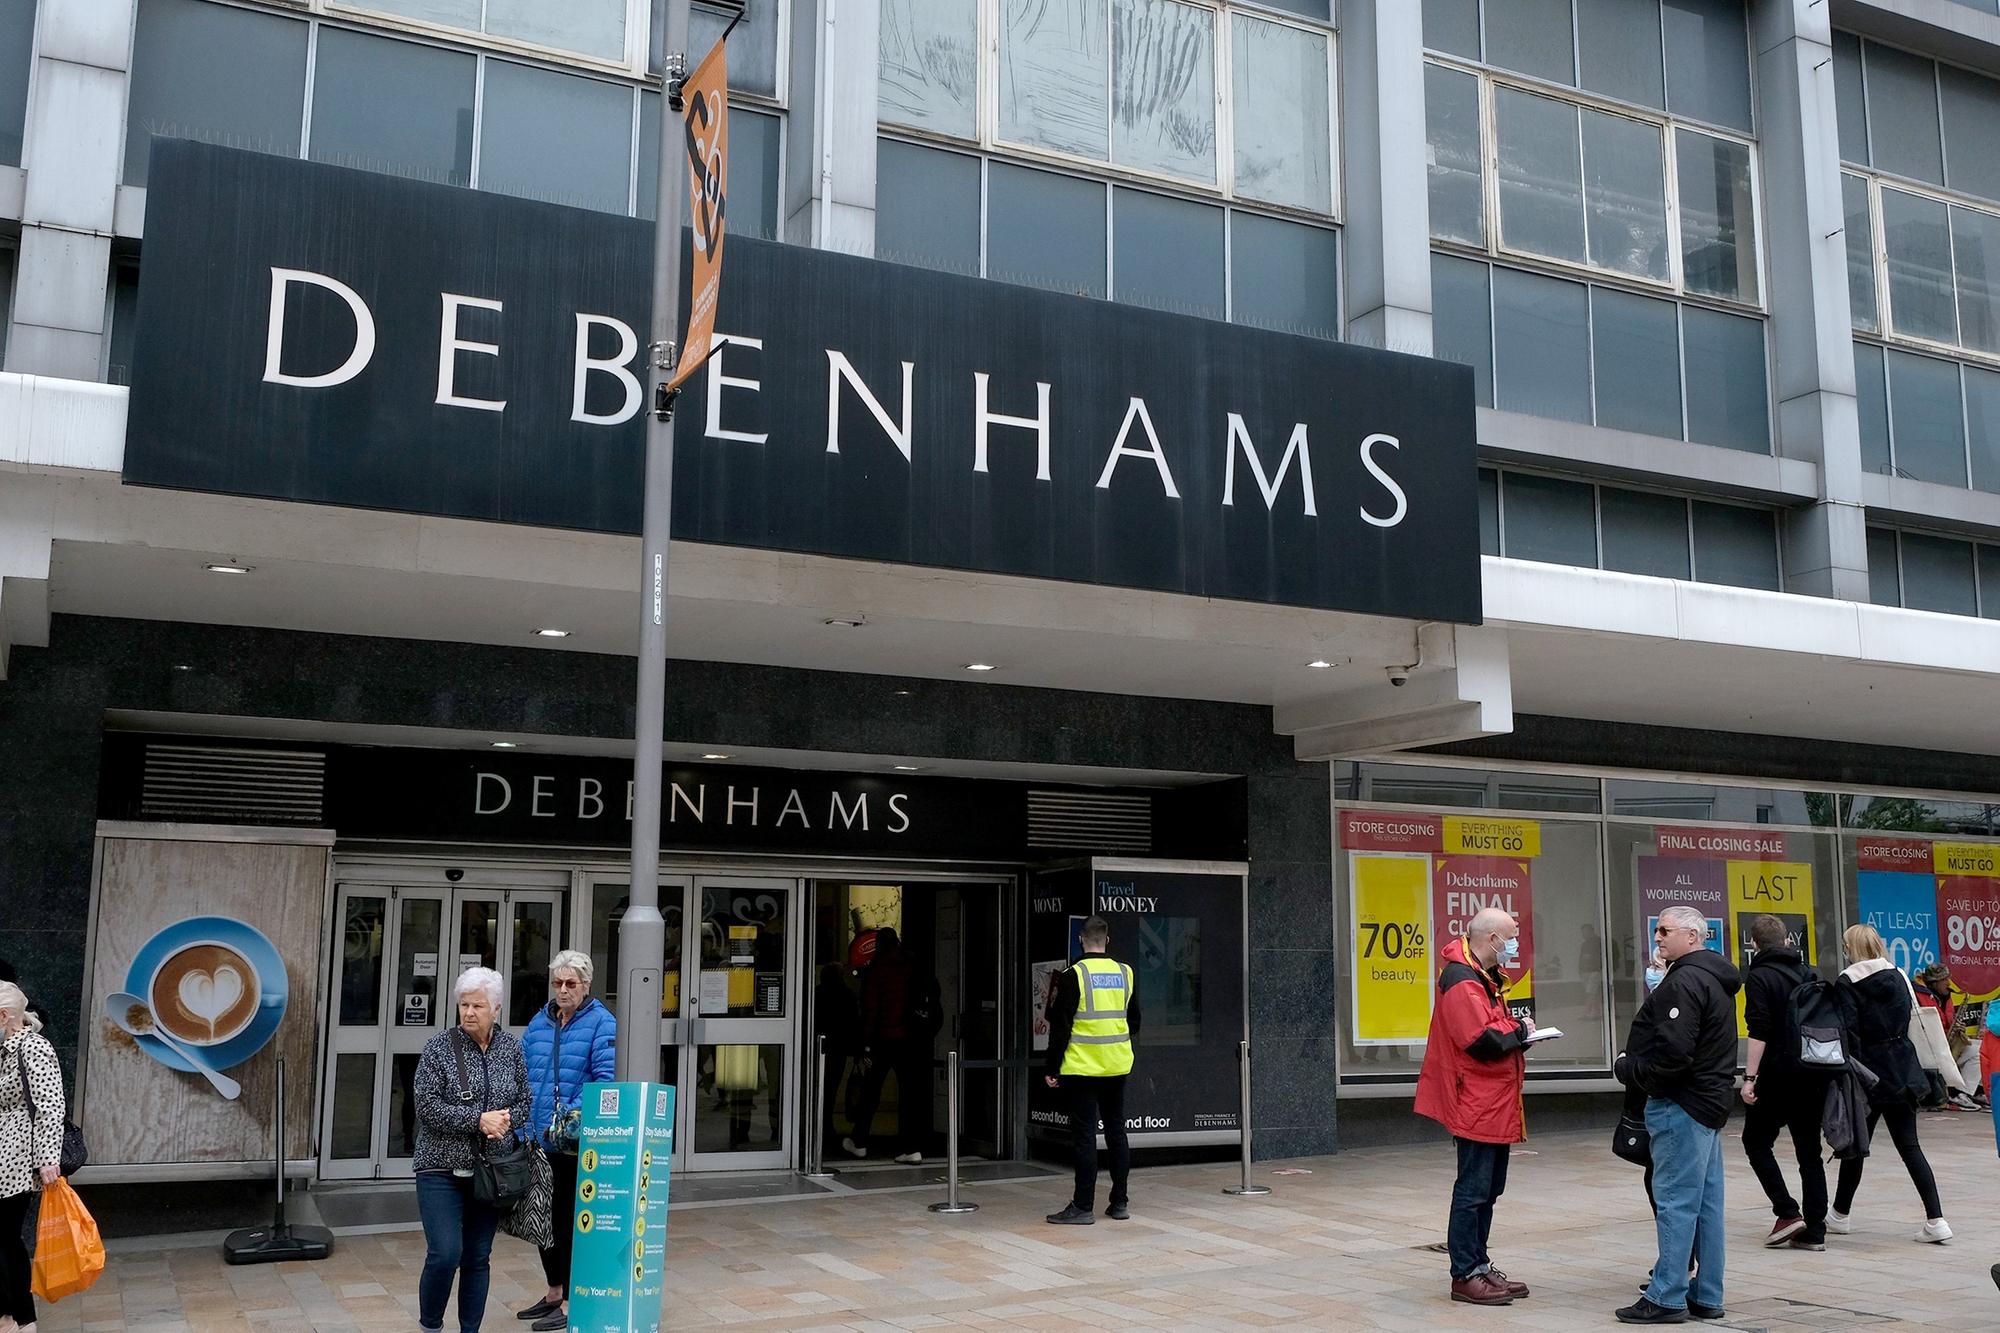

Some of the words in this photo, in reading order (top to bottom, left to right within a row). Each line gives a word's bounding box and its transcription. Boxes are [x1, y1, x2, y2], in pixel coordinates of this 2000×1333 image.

[263, 266, 1409, 528] DEBENHAMS
[1349, 821, 1385, 834] STORE
[1386, 823, 1435, 836] CLOSING
[1461, 822, 1523, 836] EVERYTHING
[1462, 835, 1499, 849] MUST
[1501, 837, 1523, 851] GO
[1660, 835, 1696, 849] FINAL
[1699, 837, 1751, 852] CLOSING
[1754, 839, 1783, 853] SALE
[1863, 846, 1890, 857] STORE
[1891, 847, 1928, 859] CLOSING
[1947, 847, 1993, 858] EVERYTHING
[1948, 858, 1976, 870] MUST
[1977, 859, 1994, 871] GO
[1446, 871, 1519, 889] Debenhams
[1674, 874, 1693, 885] ALL
[1099, 881, 1135, 896] Travel
[1646, 888, 1721, 902] WOMENSWEAR
[1742, 875, 1798, 901] LAST
[1033, 897, 1064, 913] MONEY
[1099, 896, 1158, 913] MONEY
[1446, 892, 1519, 917] FINAL
[1946, 898, 1971, 911] SAVE
[1972, 900, 1985, 912] UP
[1987, 901, 2000, 912] TO
[1866, 911, 1885, 929] AT
[1888, 912, 1931, 930] LEAST
[1786, 932, 1803, 946] AY
[1947, 914, 2000, 951] 80%
[1360, 922, 1425, 959] 70%
[1404, 947, 1425, 959] OFF
[1881, 937, 1935, 977] 0%
[1950, 954, 1982, 966] ORIGINAL
[1092, 974, 1123, 988] SECURITY
[1372, 966, 1417, 984] beauty
[1031, 1110, 1054, 1123] second
[1054, 1111, 1069, 1125] floor
[1098, 1116, 1142, 1129] snd
[1145, 1115, 1171, 1128] floor
[1194, 1119, 1237, 1127] DEBENHAMS
[582, 1126, 598, 1138] Stay
[598, 1126, 614, 1136] Safe
[614, 1126, 634, 1136] Sheff
[645, 1126, 654, 1138] Stay
[653, 1127, 663, 1137] Safe
[575, 1286, 590, 1297] Play
[590, 1286, 606, 1296] Your
[607, 1288, 622, 1297] Part
